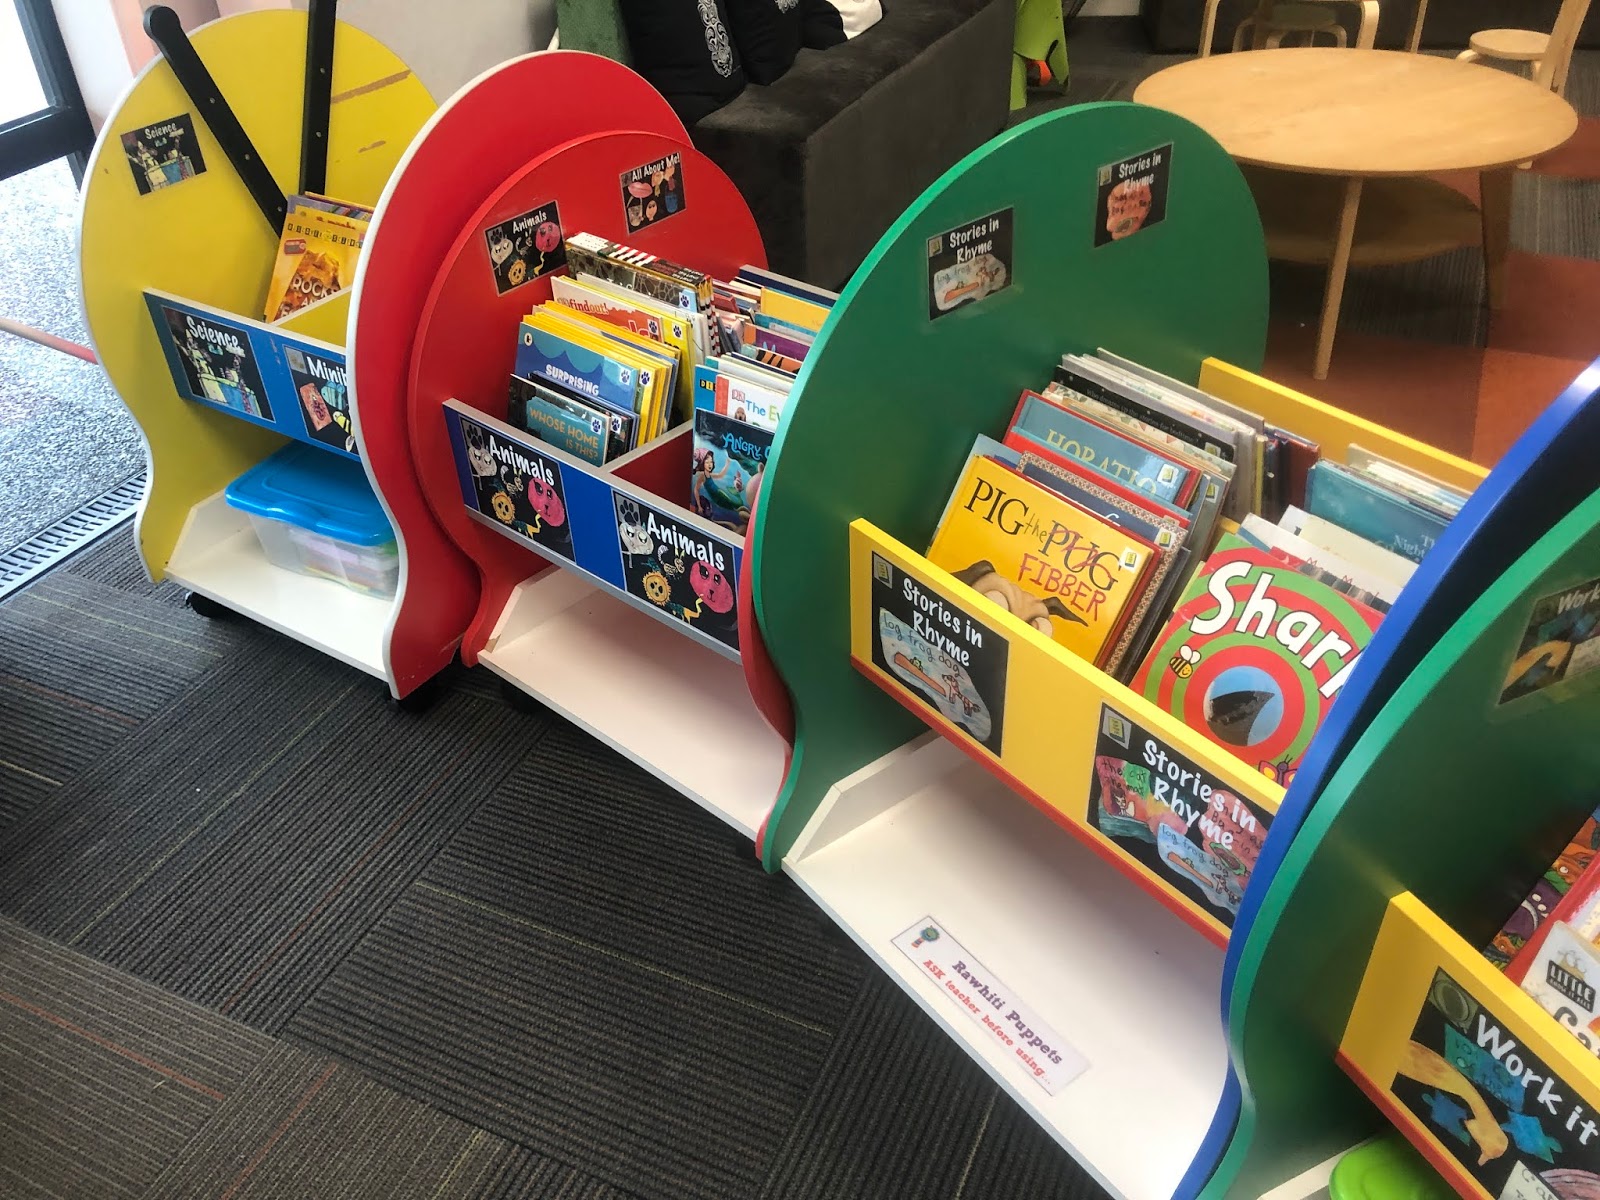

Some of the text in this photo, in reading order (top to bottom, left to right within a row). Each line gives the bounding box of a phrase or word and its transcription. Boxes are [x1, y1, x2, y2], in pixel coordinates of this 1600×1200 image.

[144, 122, 178, 140] Science
[632, 152, 680, 182] All About Me!
[1118, 152, 1162, 179] Stories in
[1123, 173, 1154, 195] Rhyme
[512, 210, 548, 235] Animals
[949, 217, 1000, 249] Stories in
[956, 239, 993, 265] Rhyme
[186, 315, 241, 348] Science
[529, 406, 600, 450] WHOSE HOME
[745, 399, 766, 417] The
[488, 435, 555, 486] Animals
[565, 438, 600, 461] IS THIS?
[720, 432, 764, 461] ANGRY
[646, 512, 725, 572] Animals
[963, 476, 1124, 592] PIG the PUG
[1017, 552, 1107, 622] FIBBER
[902, 577, 982, 649] Stories in
[883, 612, 965, 681] log frog dog
[912, 610, 970, 667] Rhyme
[1142, 739, 1225, 812] Stories
[1231, 798, 1256, 833] in
[1153, 776, 1234, 851] Rhyme
[922, 959, 947, 981] ASK
[945, 979, 981, 1015] teacher
[981, 1013, 1014, 1047] before
[1550, 964, 1594, 1002] LITTLE
[951, 960, 1063, 1065] Rawhiti Puppets
[1476, 1013, 1563, 1116] Work
[1564, 1104, 1600, 1147] it
